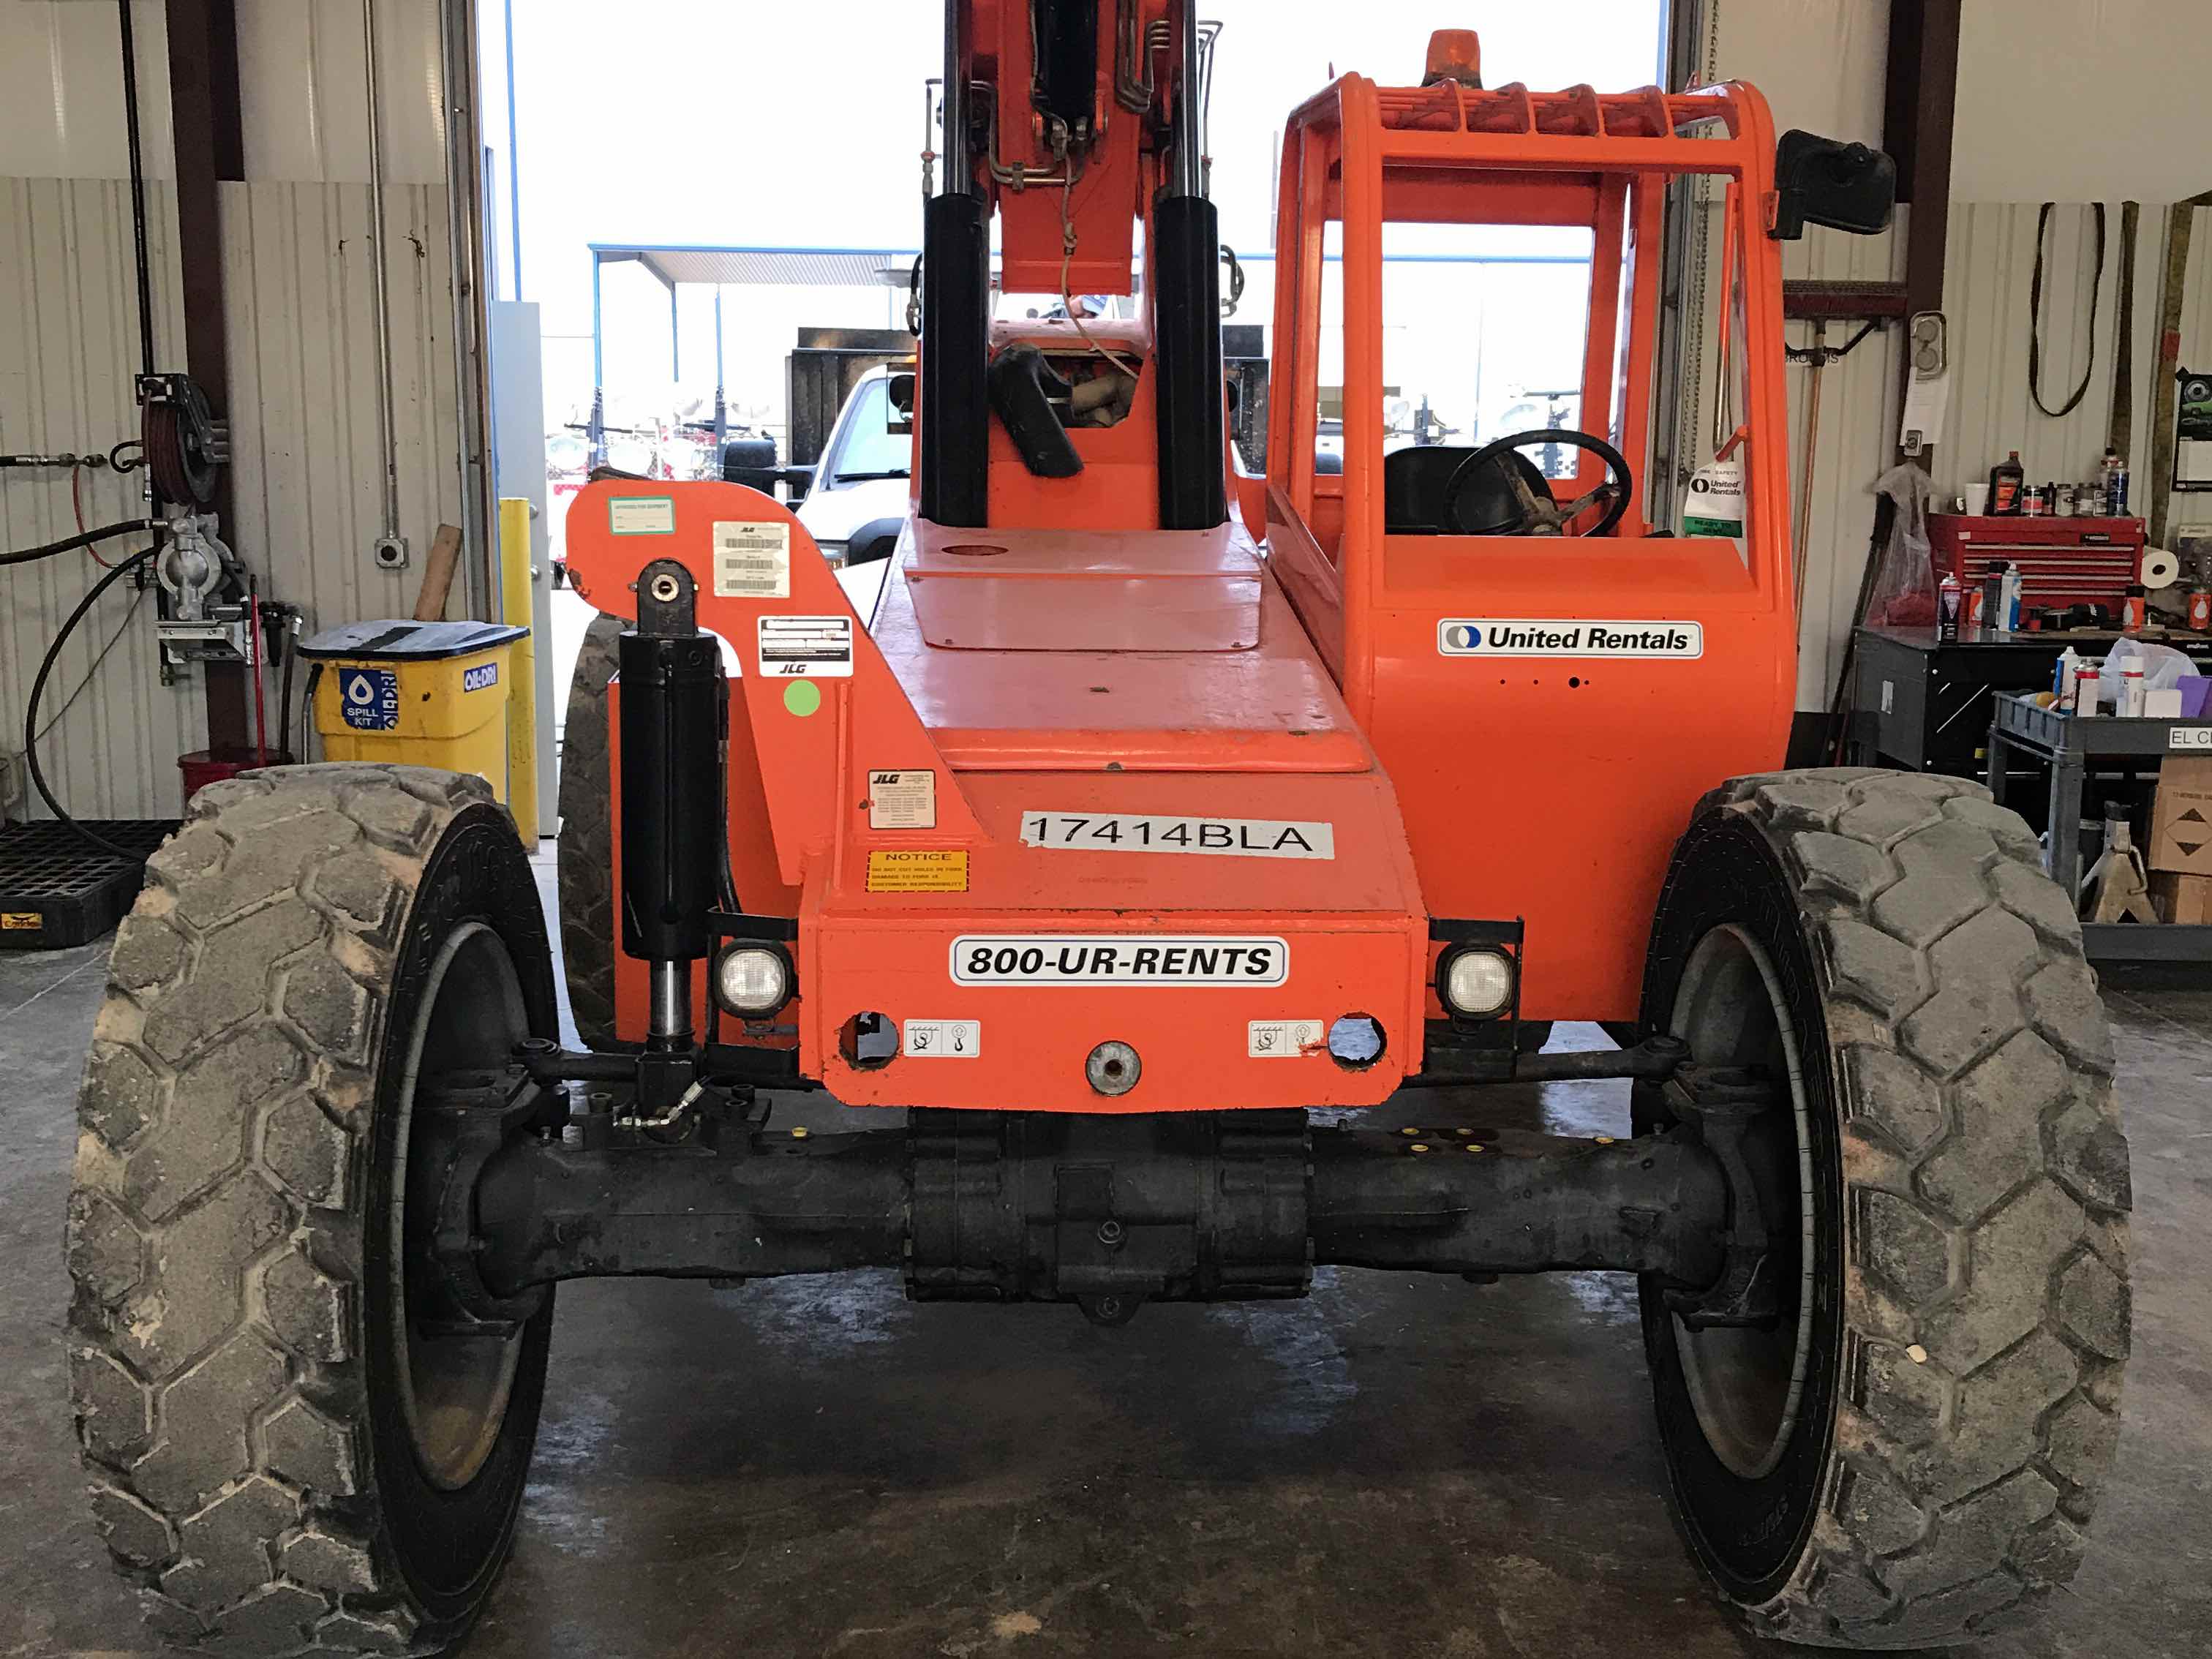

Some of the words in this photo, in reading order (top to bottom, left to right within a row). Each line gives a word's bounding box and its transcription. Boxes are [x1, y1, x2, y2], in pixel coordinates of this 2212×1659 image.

[1489, 627, 1580, 648] United
[1587, 628, 1688, 650] Rentals
[779, 664, 807, 674] JLG
[347, 707, 378, 718] SPILL
[354, 717, 372, 726] KIT
[2172, 731, 2192, 744] EL
[2197, 731, 2212, 744] C
[873, 774, 900, 784] JLG
[1029, 817, 1313, 851] 17414BLA
[968, 948, 1271, 974] 800-UR-RENTS
